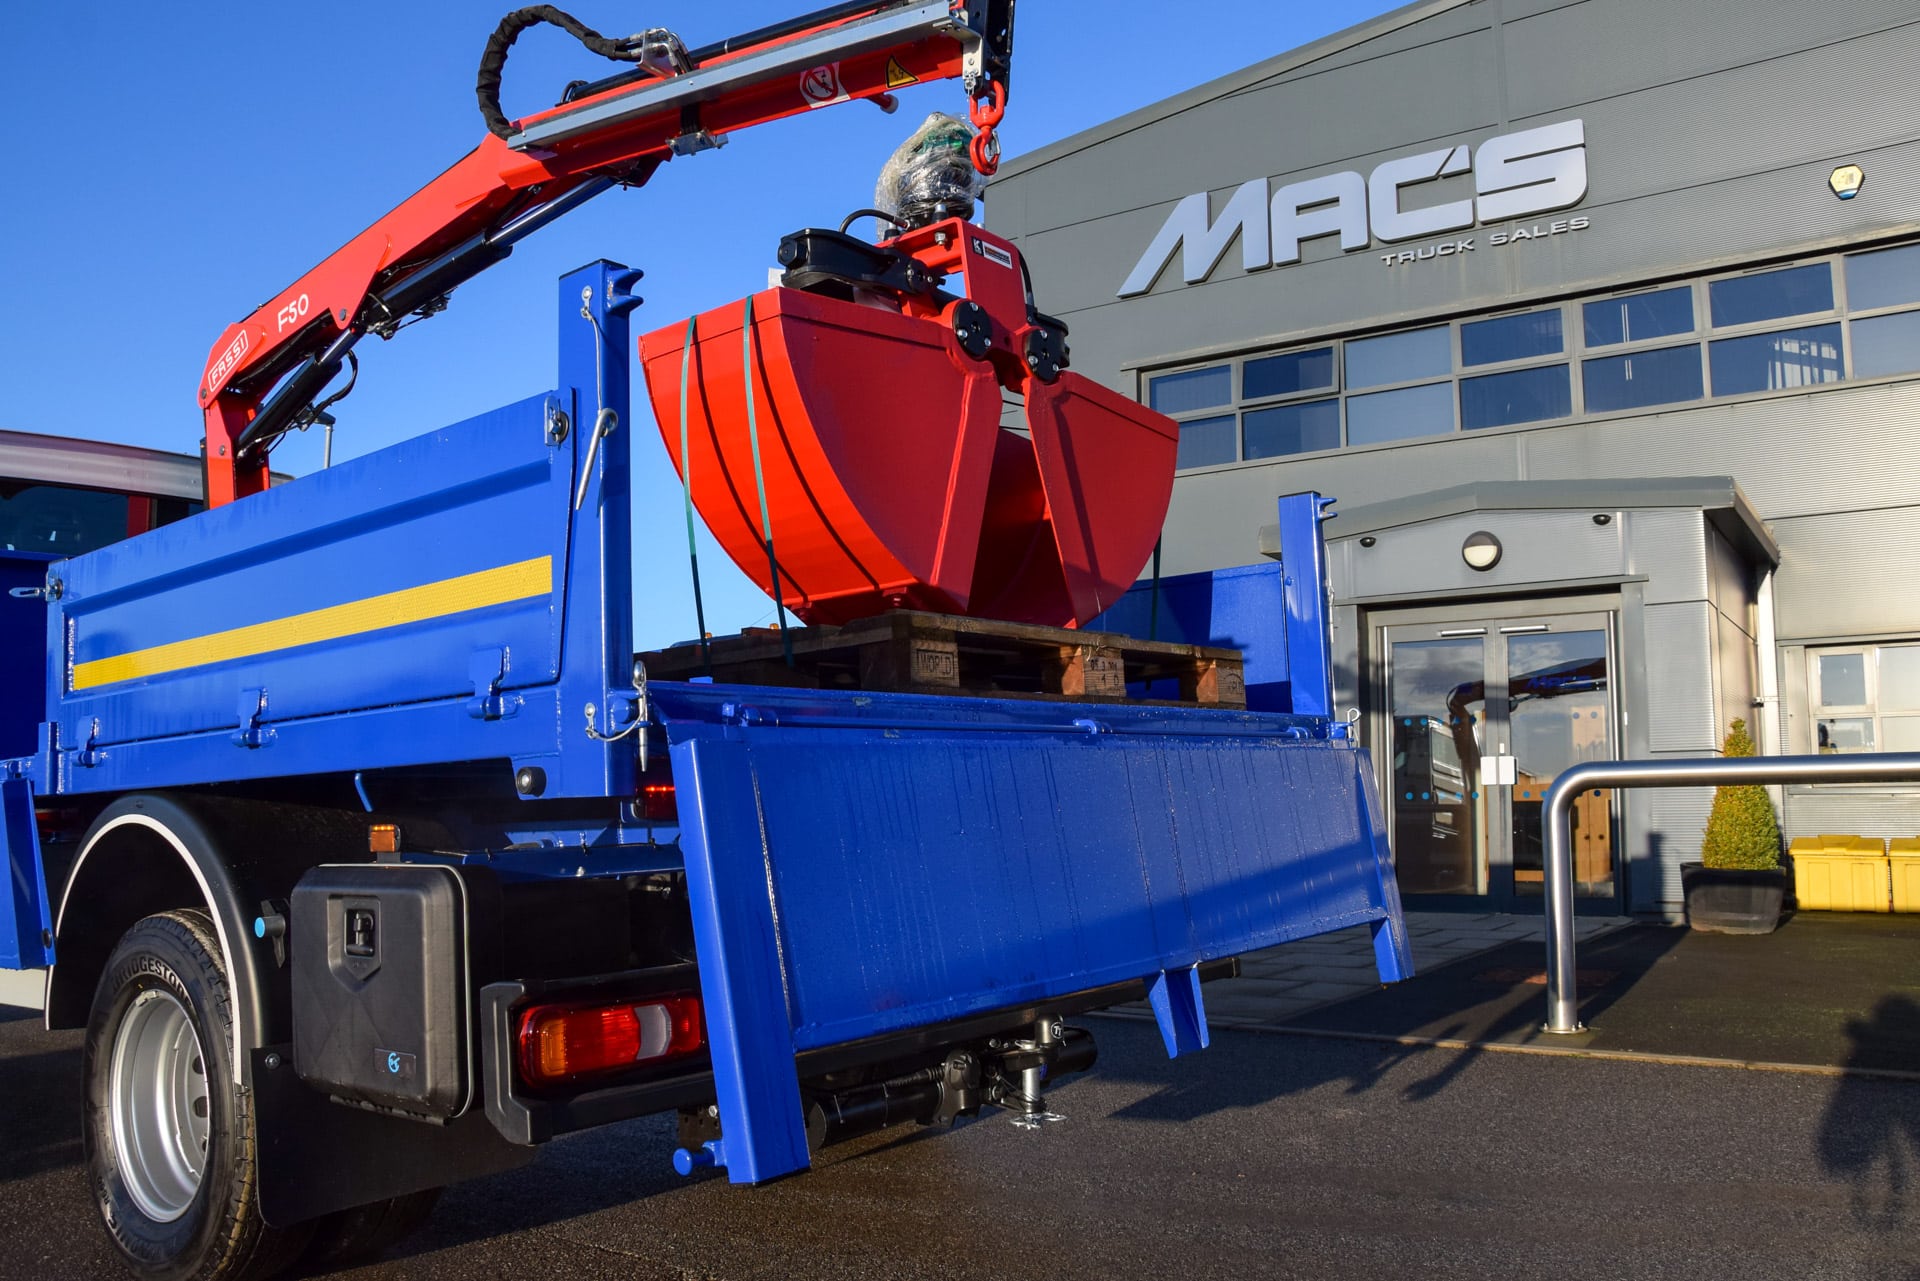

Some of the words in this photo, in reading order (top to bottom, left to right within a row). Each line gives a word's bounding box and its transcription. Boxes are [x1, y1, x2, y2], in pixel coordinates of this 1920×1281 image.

[1380, 238, 1475, 267] TRUCK
[1489, 216, 1591, 246] SALES
[277, 293, 309, 333] F50
[211, 337, 246, 385] FASSI
